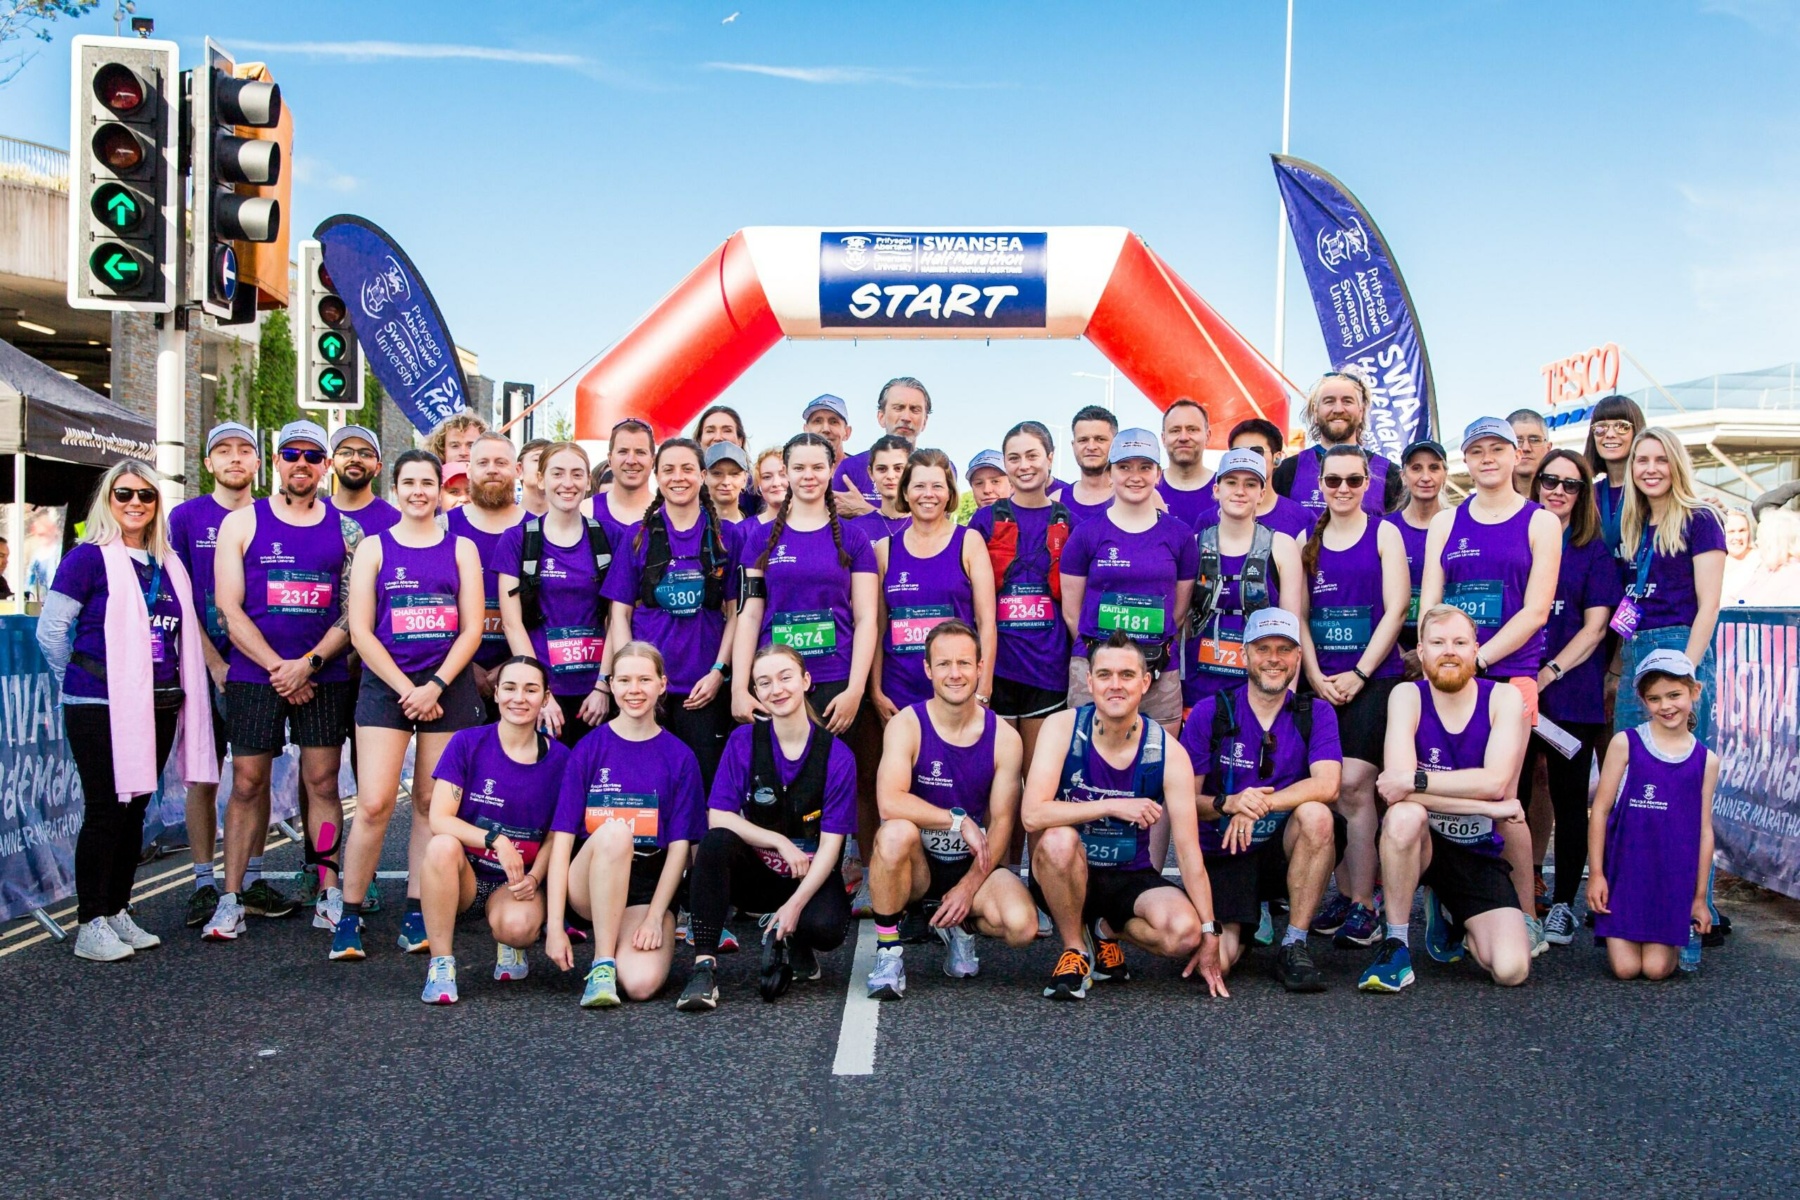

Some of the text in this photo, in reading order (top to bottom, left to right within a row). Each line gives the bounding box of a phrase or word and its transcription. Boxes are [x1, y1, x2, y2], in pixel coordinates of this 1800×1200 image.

[923, 237, 1023, 251] SWANSEA
[921, 251, 1025, 266] Half Marathon
[849, 283, 1018, 319] START
[1355, 271, 1381, 335] Abertawe
[1367, 267, 1393, 327] Prifysgol
[1329, 284, 1354, 349] University
[1340, 279, 1365, 343] Swansea
[401, 311, 437, 368] Abertawe
[375, 329, 415, 387] University
[384, 322, 420, 380] Swansea
[1541, 341, 1620, 405] TESCO
[281, 590, 319, 605] 2312
[393, 607, 437, 616] CHARLOTTE
[1009, 604, 1045, 619] 2345
[1101, 606, 1129, 614] CAITLIN
[405, 615, 446, 631] 3064
[1113, 615, 1149, 630] 1181
[1618, 611, 1637, 625] VIP
[774, 625, 793, 634] EMILY
[1325, 628, 1353, 642] 488
[549, 640, 583, 649] REBEKAH
[784, 631, 824, 647] 2674
[562, 647, 595, 661] 3517
[588, 809, 614, 817] TEGAN
[1438, 822, 1480, 836] 1605
